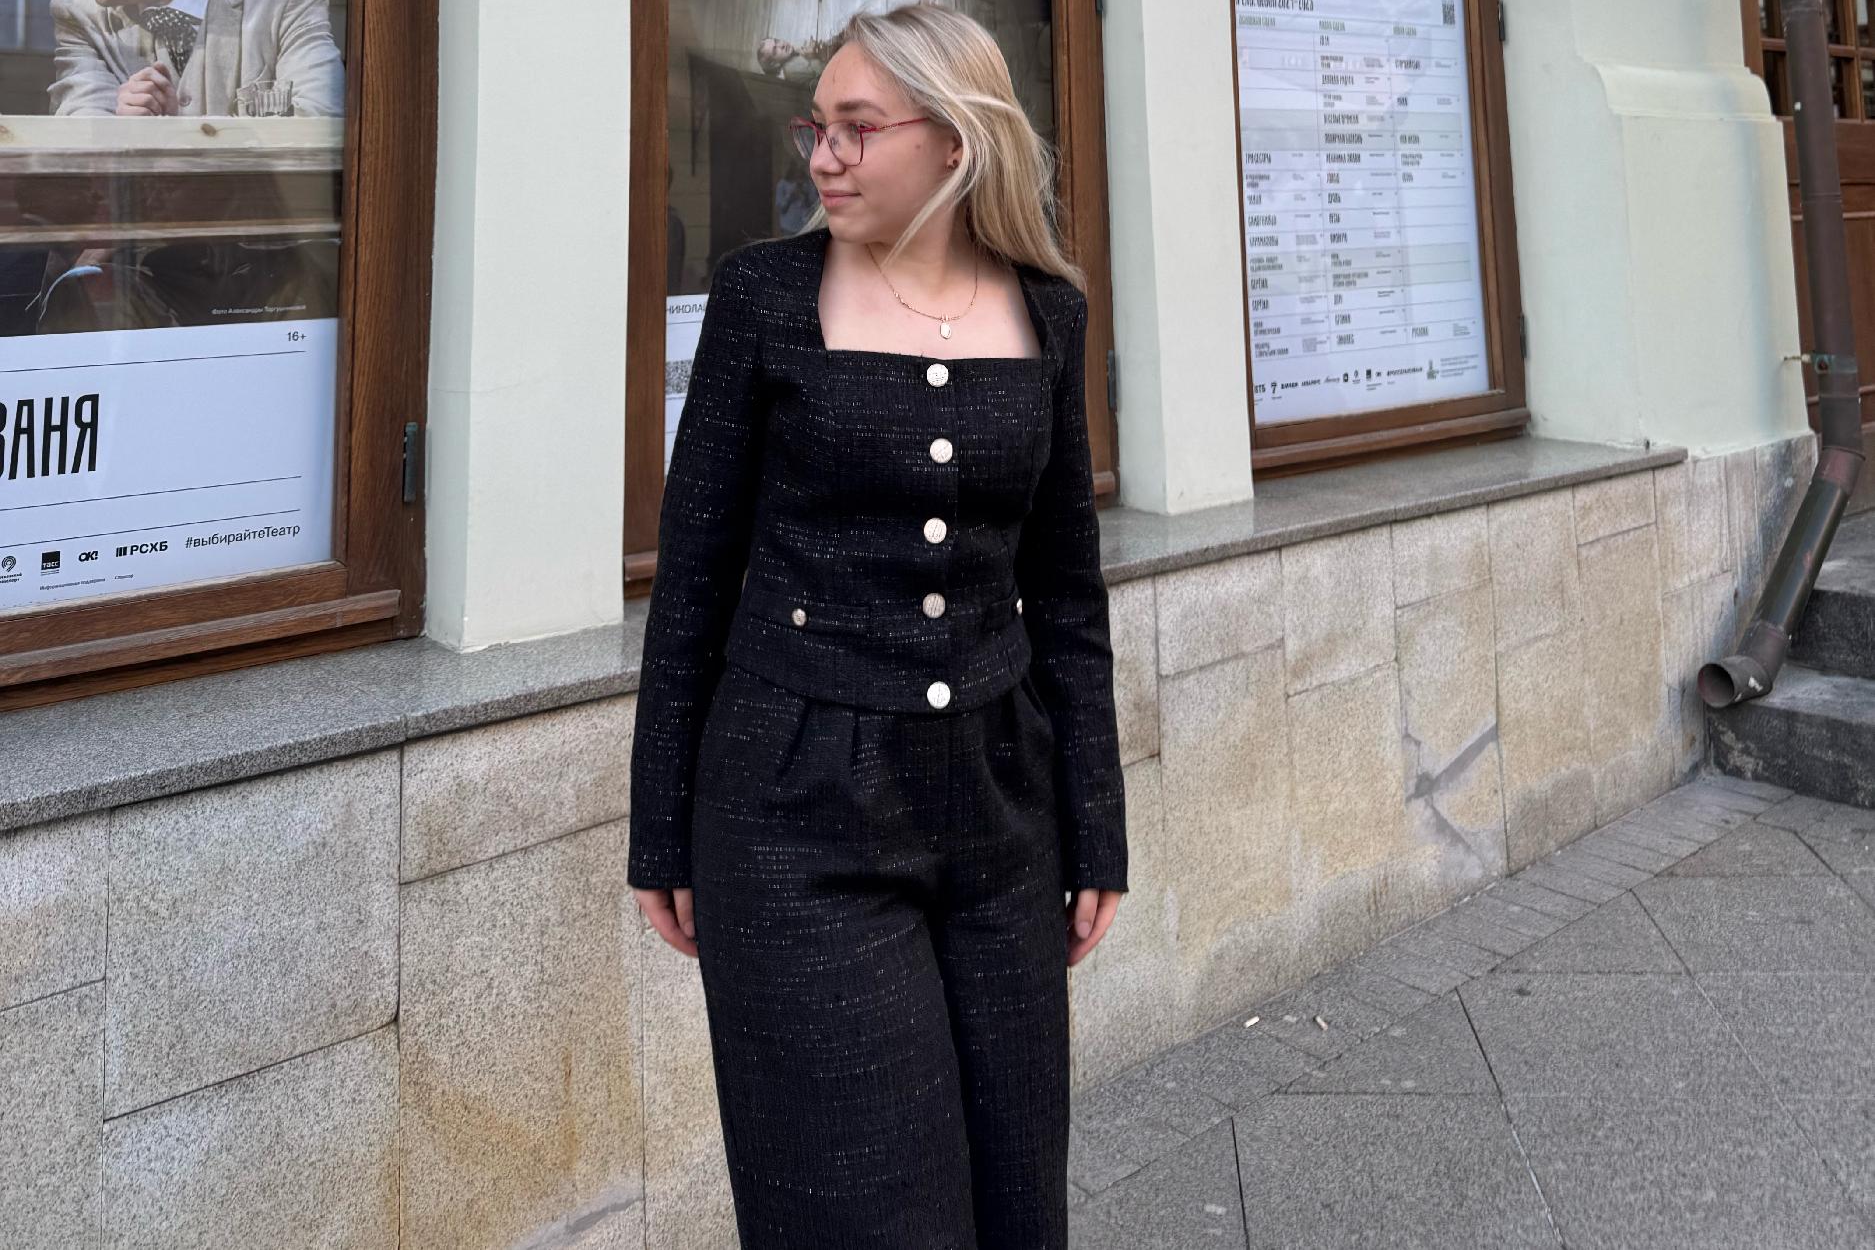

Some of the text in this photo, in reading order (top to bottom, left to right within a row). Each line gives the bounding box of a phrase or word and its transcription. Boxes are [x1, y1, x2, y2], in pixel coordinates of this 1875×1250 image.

[287, 330, 307, 342] 16+
[185, 524, 301, 549] #выбирайтеТеатр
[130, 540, 169, 556] РСХБ
